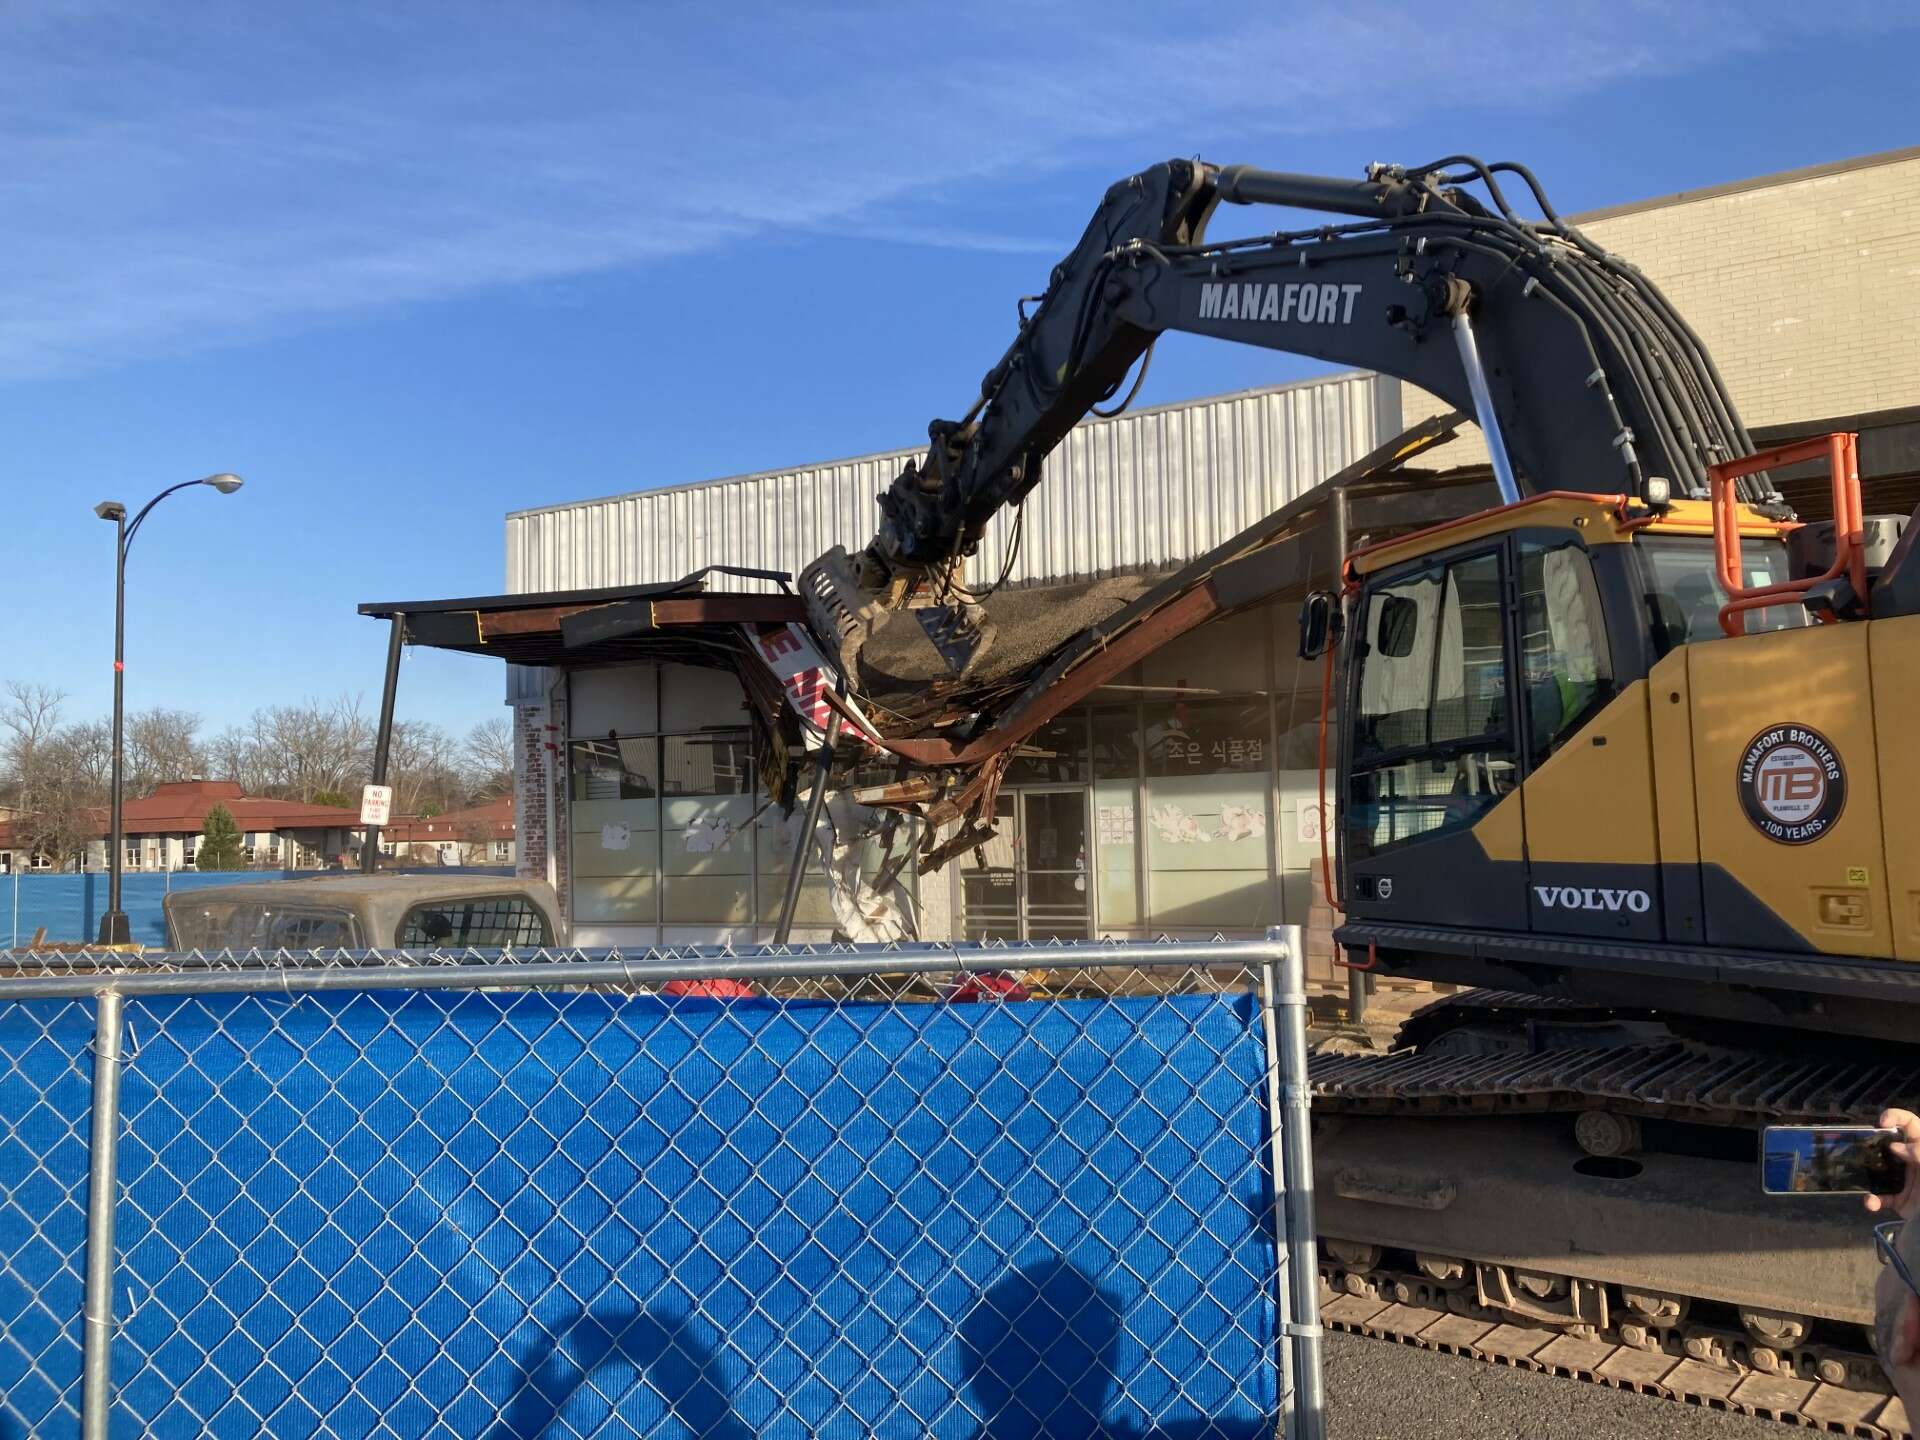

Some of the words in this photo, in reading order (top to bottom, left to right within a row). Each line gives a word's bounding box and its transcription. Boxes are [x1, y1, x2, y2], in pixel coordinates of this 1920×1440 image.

[1199, 283, 1363, 324] MANAFORT
[1211, 738, 1263, 763] 식품점
[1742, 729, 1785, 782] MANAFORT
[1789, 729, 1840, 780] BROTHERS
[372, 790, 383, 798] NO
[1766, 820, 1783, 837] 100
[1785, 819, 1823, 839] YEARS
[1534, 886, 1650, 912] VOLVO
